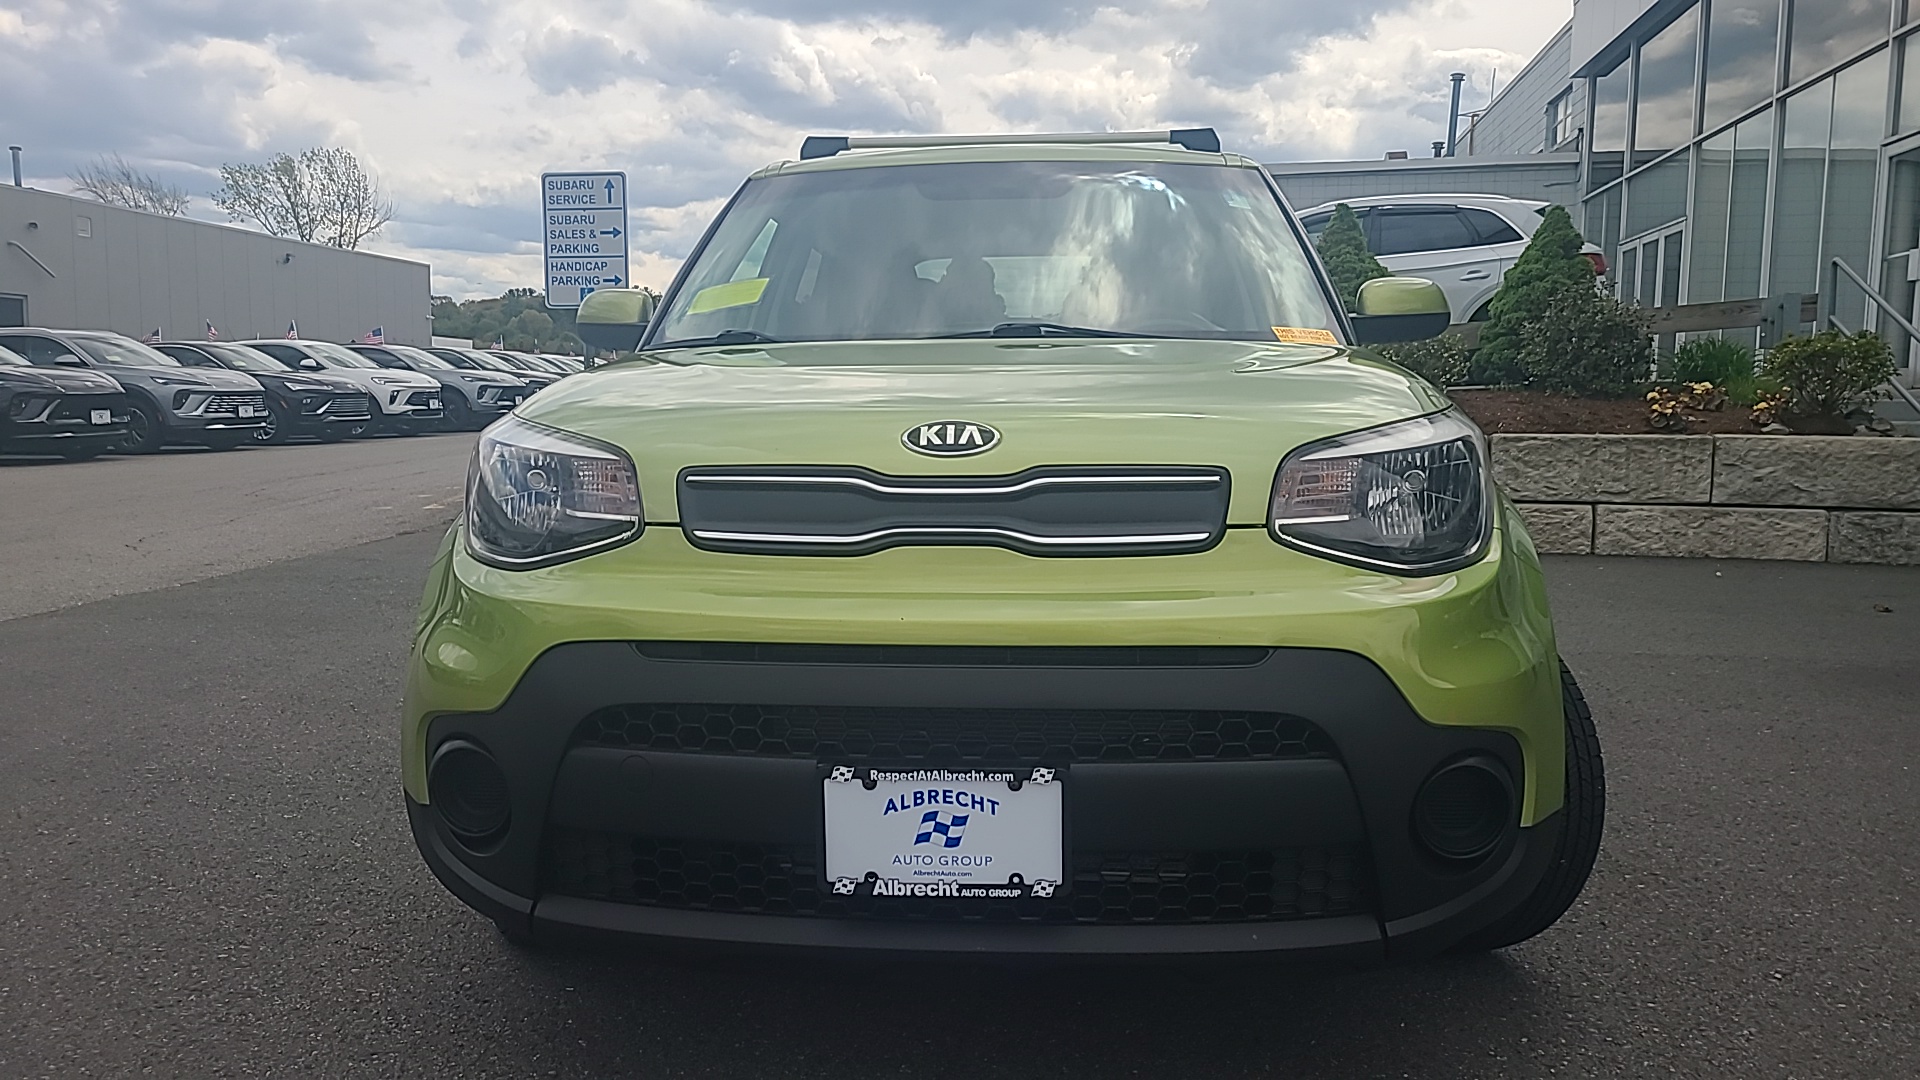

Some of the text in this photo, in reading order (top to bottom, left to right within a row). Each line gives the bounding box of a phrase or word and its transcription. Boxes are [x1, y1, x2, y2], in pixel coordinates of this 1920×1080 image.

[548, 180, 594, 190] SUBARU
[548, 194, 596, 205] SERVICE
[549, 215, 595, 225] SUBARU
[550, 229, 597, 239] SALES &
[550, 244, 600, 254] PARKING
[550, 261, 608, 272] HANDICAP
[551, 276, 600, 286] PARKING
[1296, 329, 1331, 337] VEHICLE
[919, 424, 984, 446] KIA
[870, 769, 1014, 783] RespectAtAlbrecht.com
[883, 789, 1000, 816] ALBRECHT
[892, 854, 993, 867] AUTO GROUP
[912, 869, 973, 877] AlbrechtAuto.com
[872, 879, 1022, 898] Albrecht AUTO GROUP
